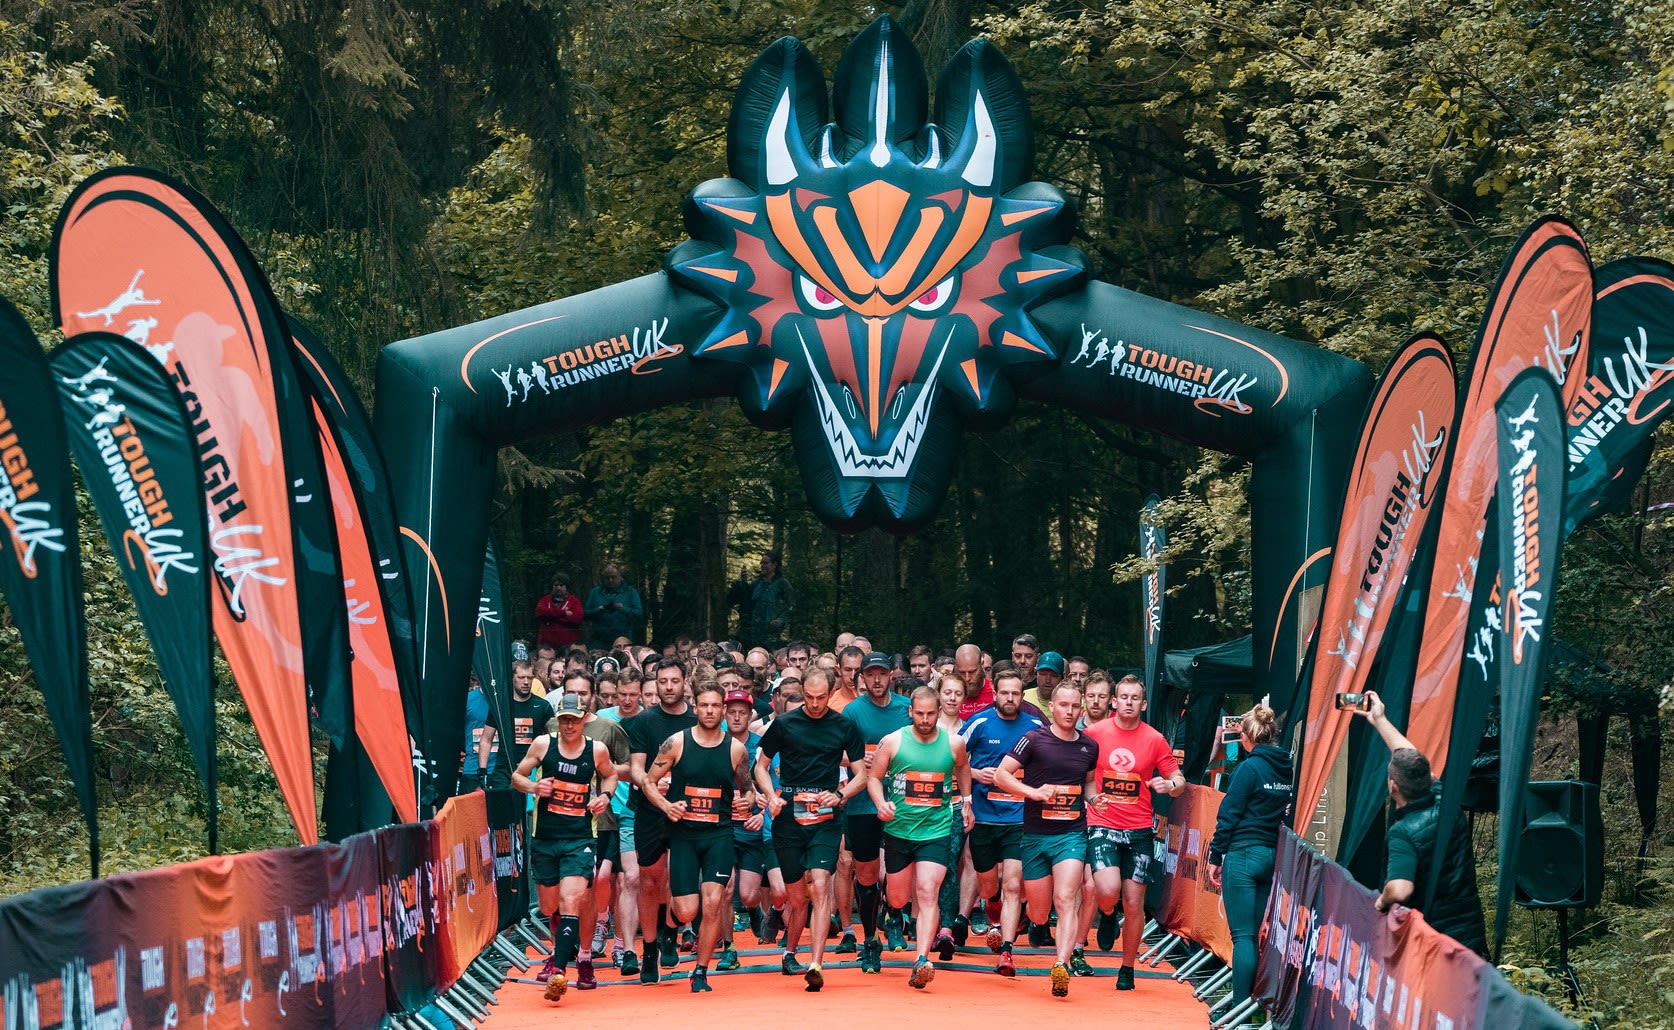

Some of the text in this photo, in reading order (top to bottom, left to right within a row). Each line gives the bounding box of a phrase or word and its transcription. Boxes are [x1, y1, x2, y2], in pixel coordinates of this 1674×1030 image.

[543, 334, 631, 375] TOUGH
[632, 317, 680, 360] UK
[1128, 343, 1214, 385] TOUGH
[1604, 326, 1674, 399] UK
[550, 353, 637, 391] RUNNER
[1119, 362, 1209, 399] RUNNER
[1207, 368, 1258, 411] UK
[1402, 410, 1443, 485] UK
[1568, 397, 1631, 473] NNER
[92, 427, 151, 536] RUNNER
[112, 416, 173, 528] TOUGH
[10, 502, 67, 571] UK
[1360, 471, 1411, 593] TOUGH
[1512, 474, 1526, 596] RUNNER
[1524, 464, 1540, 589] TOUGH
[145, 528, 200, 588] UK
[212, 524, 288, 614] UK
[1516, 590, 1543, 656] UK
[553, 790, 584, 803] 370
[558, 761, 578, 775] TOM
[913, 782, 935, 793] 86
[1104, 780, 1136, 791] 440
[690, 798, 713, 809] 911
